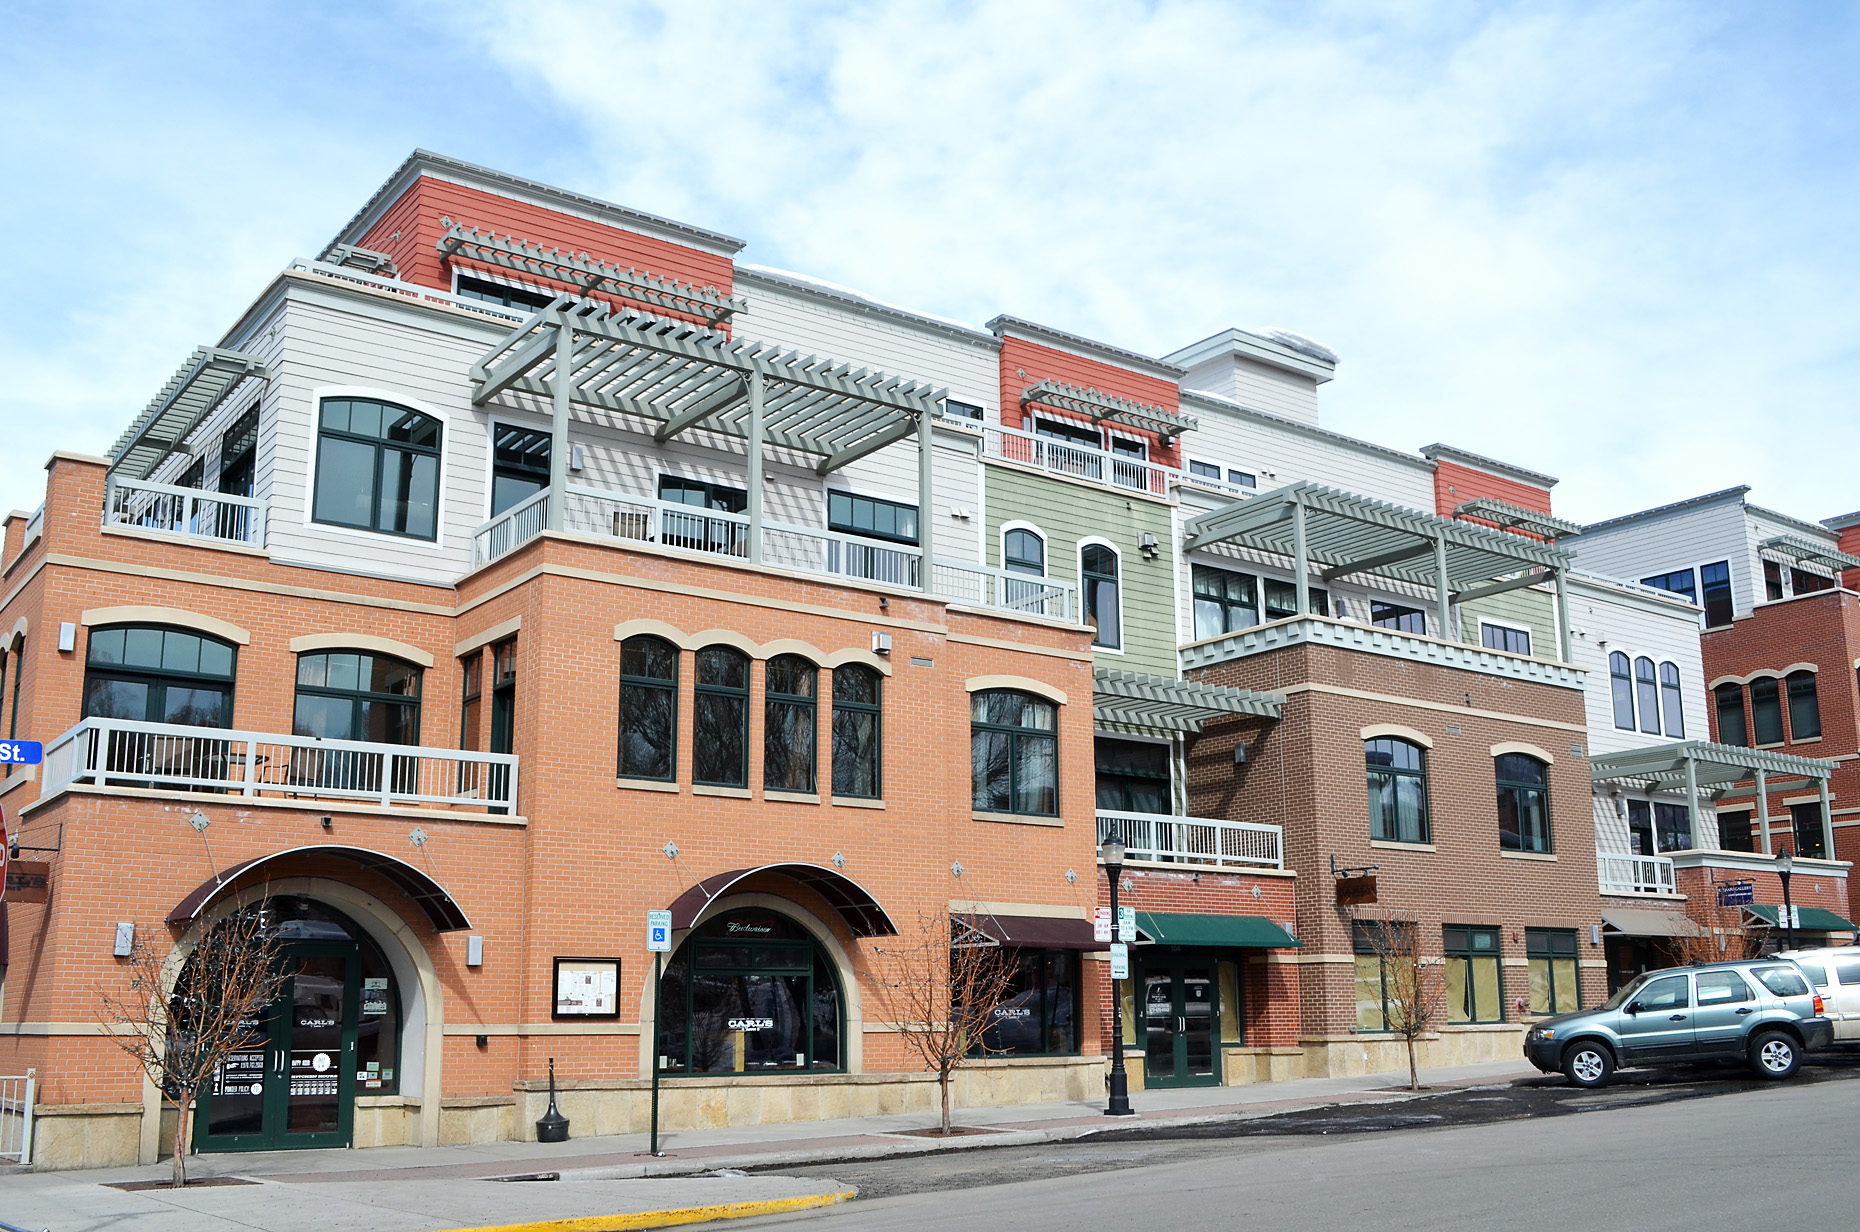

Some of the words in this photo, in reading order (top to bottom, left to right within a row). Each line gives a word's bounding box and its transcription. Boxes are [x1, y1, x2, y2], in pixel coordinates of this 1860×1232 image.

[0, 743, 25, 761] St.
[6, 876, 46, 887] RL'S
[1119, 908, 1124, 919] 3
[727, 922, 771, 933] Budweiser
[728, 1019, 774, 1028] CARL'S
